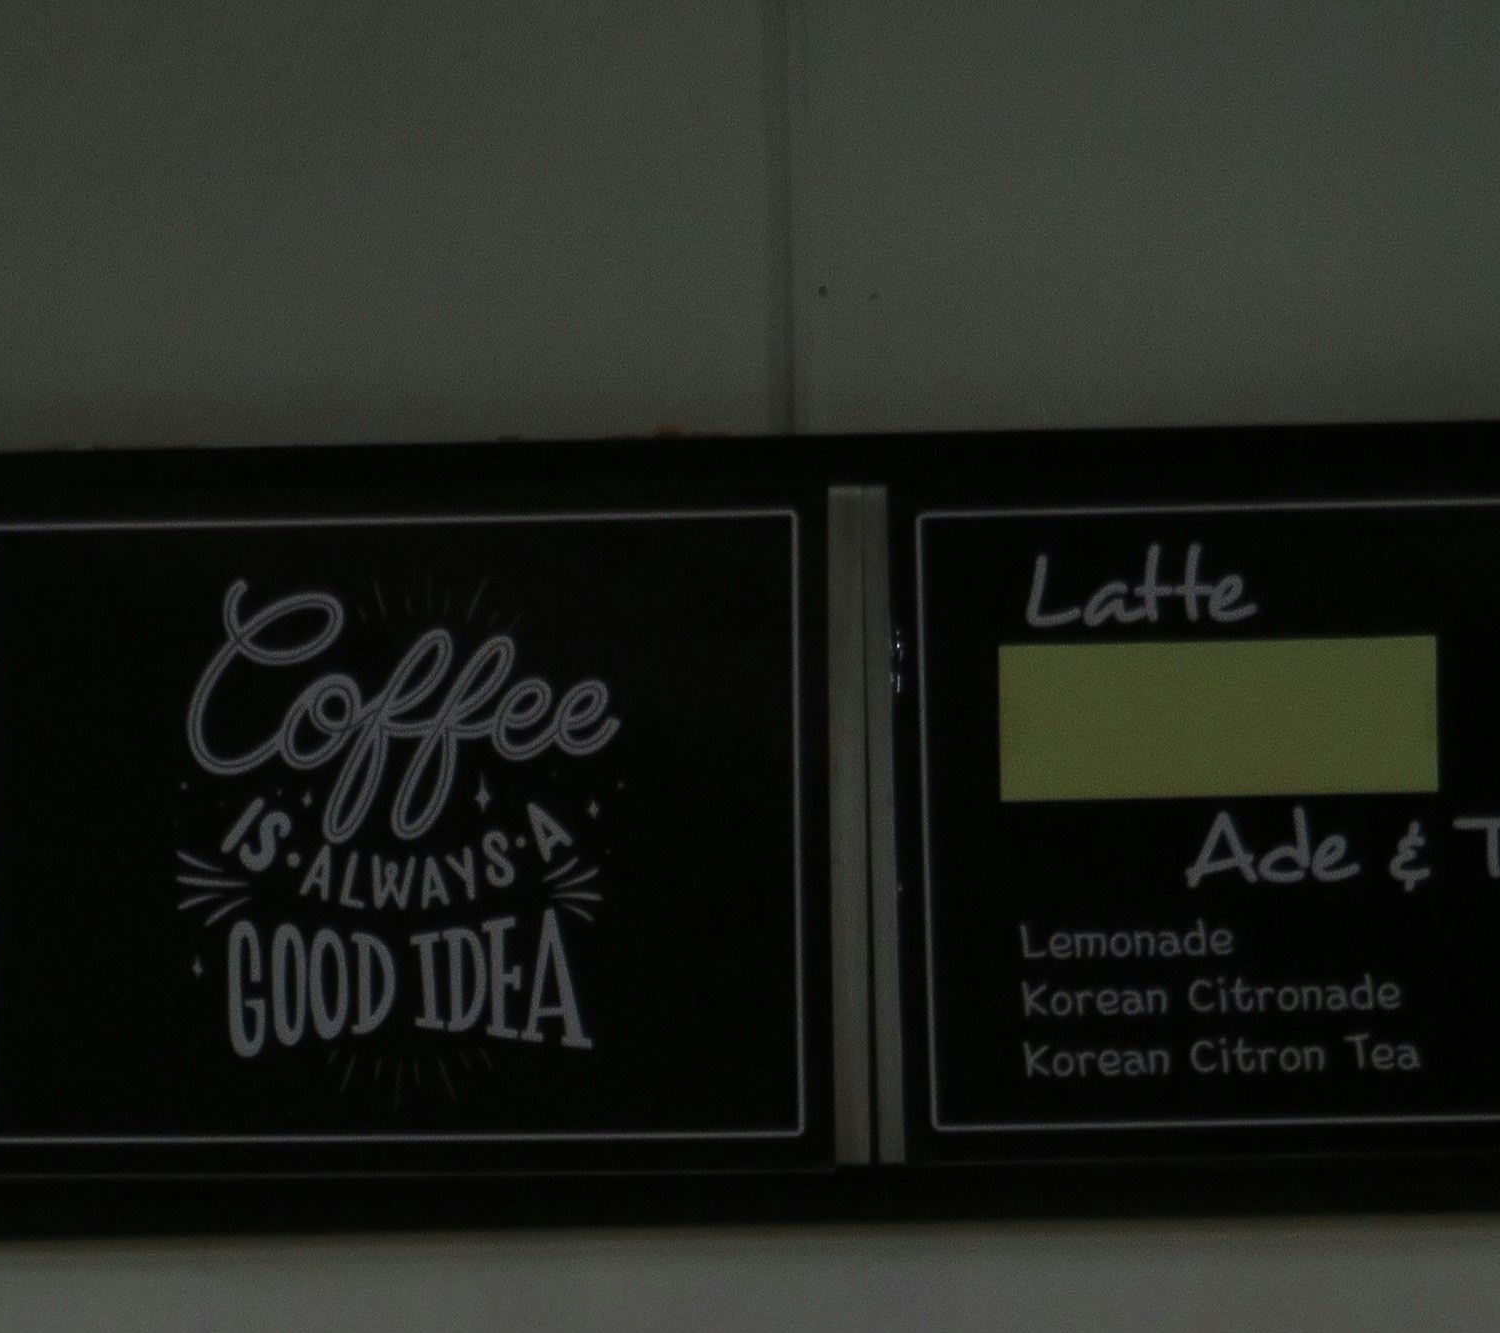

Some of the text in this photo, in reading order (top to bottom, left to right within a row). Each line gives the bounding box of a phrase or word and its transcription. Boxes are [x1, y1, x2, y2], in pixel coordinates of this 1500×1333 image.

[1025, 543, 1258, 628] Latte
[186, 578, 621, 841] Coffee
[220, 797, 573, 911] IS ALWAYS A
[1186, 806, 1361, 888] Ade
[1389, 821, 1431, 891] &
[1020, 919, 1235, 959] Lemonade
[227, 908, 593, 1059] GOOD IDEA
[1020, 972, 1401, 1017] Korean Citronade
[1023, 1033, 1420, 1078] Korean Citron Tea
